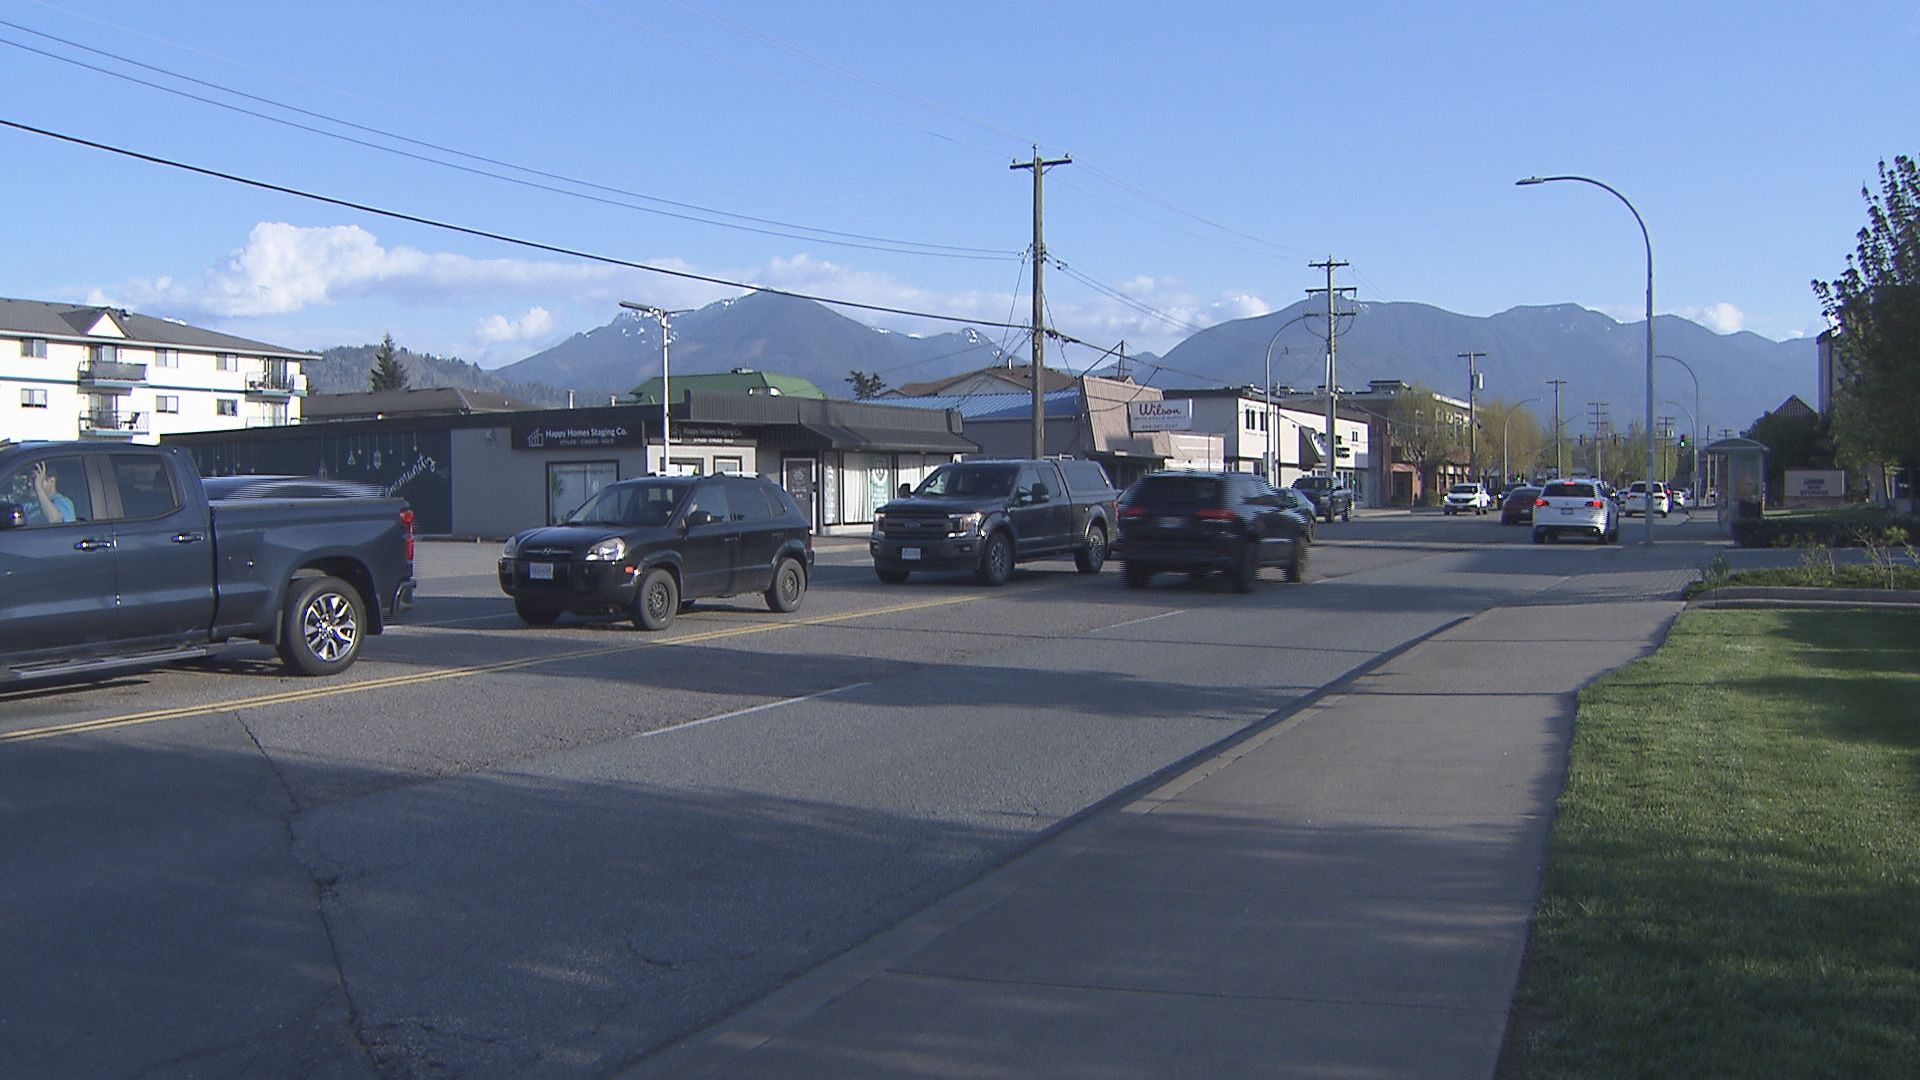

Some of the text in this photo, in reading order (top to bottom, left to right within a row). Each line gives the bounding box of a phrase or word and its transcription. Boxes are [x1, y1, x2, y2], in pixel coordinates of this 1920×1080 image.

[1139, 403, 1182, 416] Wilson
[545, 429, 567, 439] Happy
[567, 428, 590, 438] Homes
[590, 427, 616, 438] Staging
